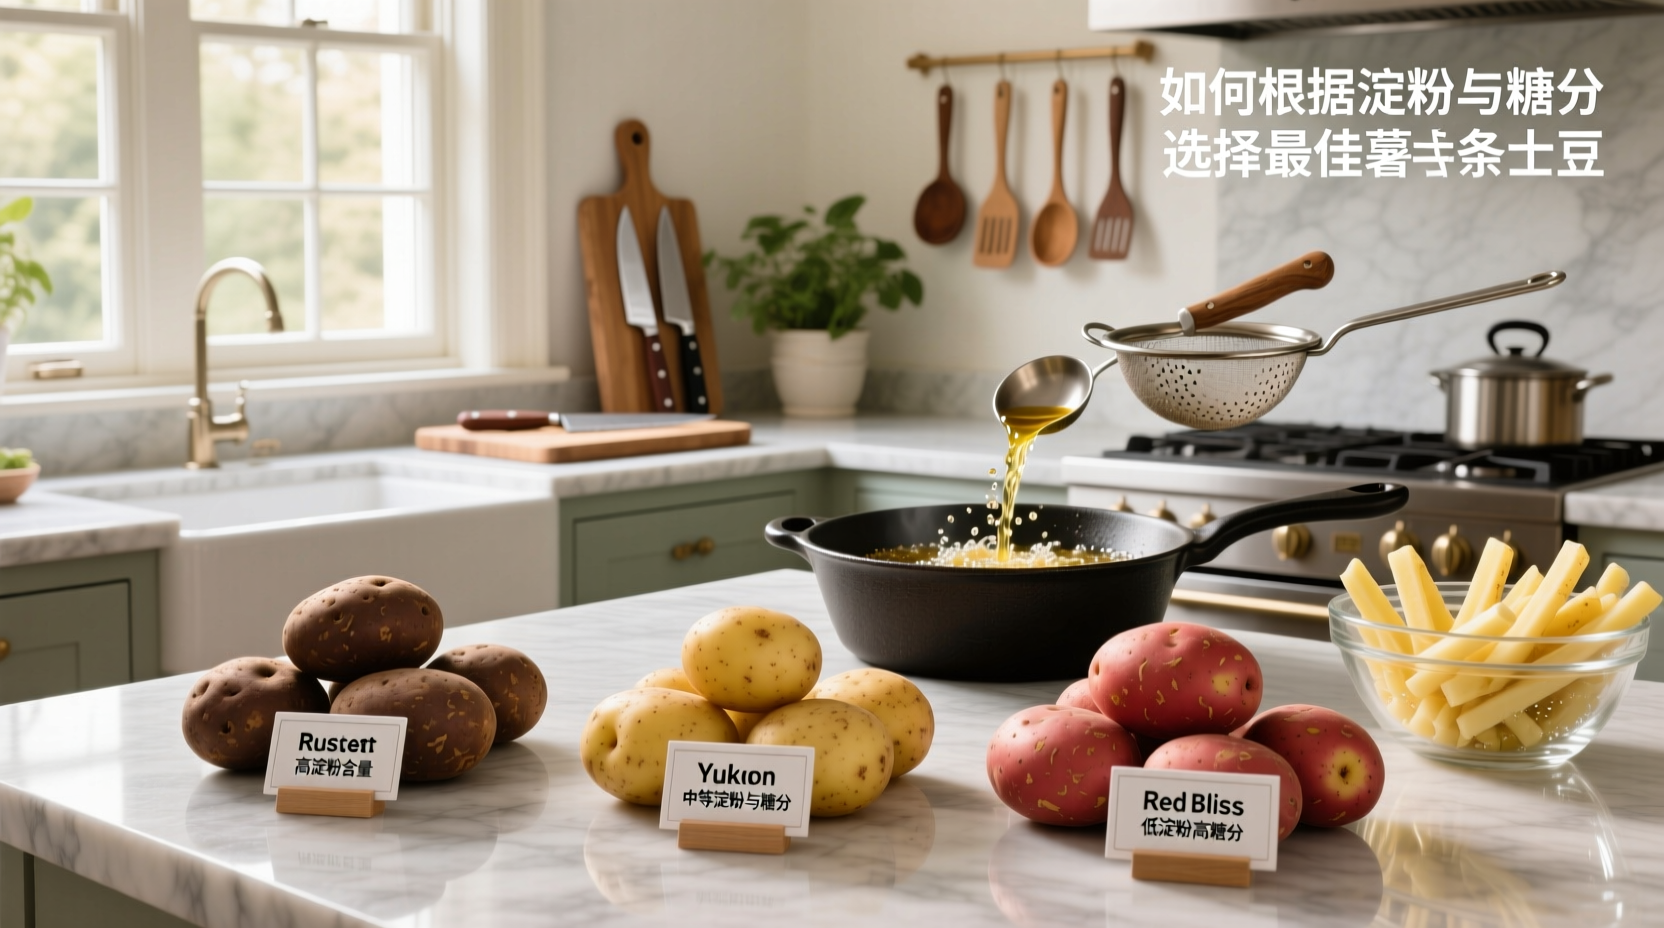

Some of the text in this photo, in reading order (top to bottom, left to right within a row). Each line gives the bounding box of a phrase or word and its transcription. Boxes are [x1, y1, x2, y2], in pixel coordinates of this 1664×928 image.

[1143, 790, 1245, 817] Red Bliss
[1140, 815, 1244, 843] 低淀粉高糖分
